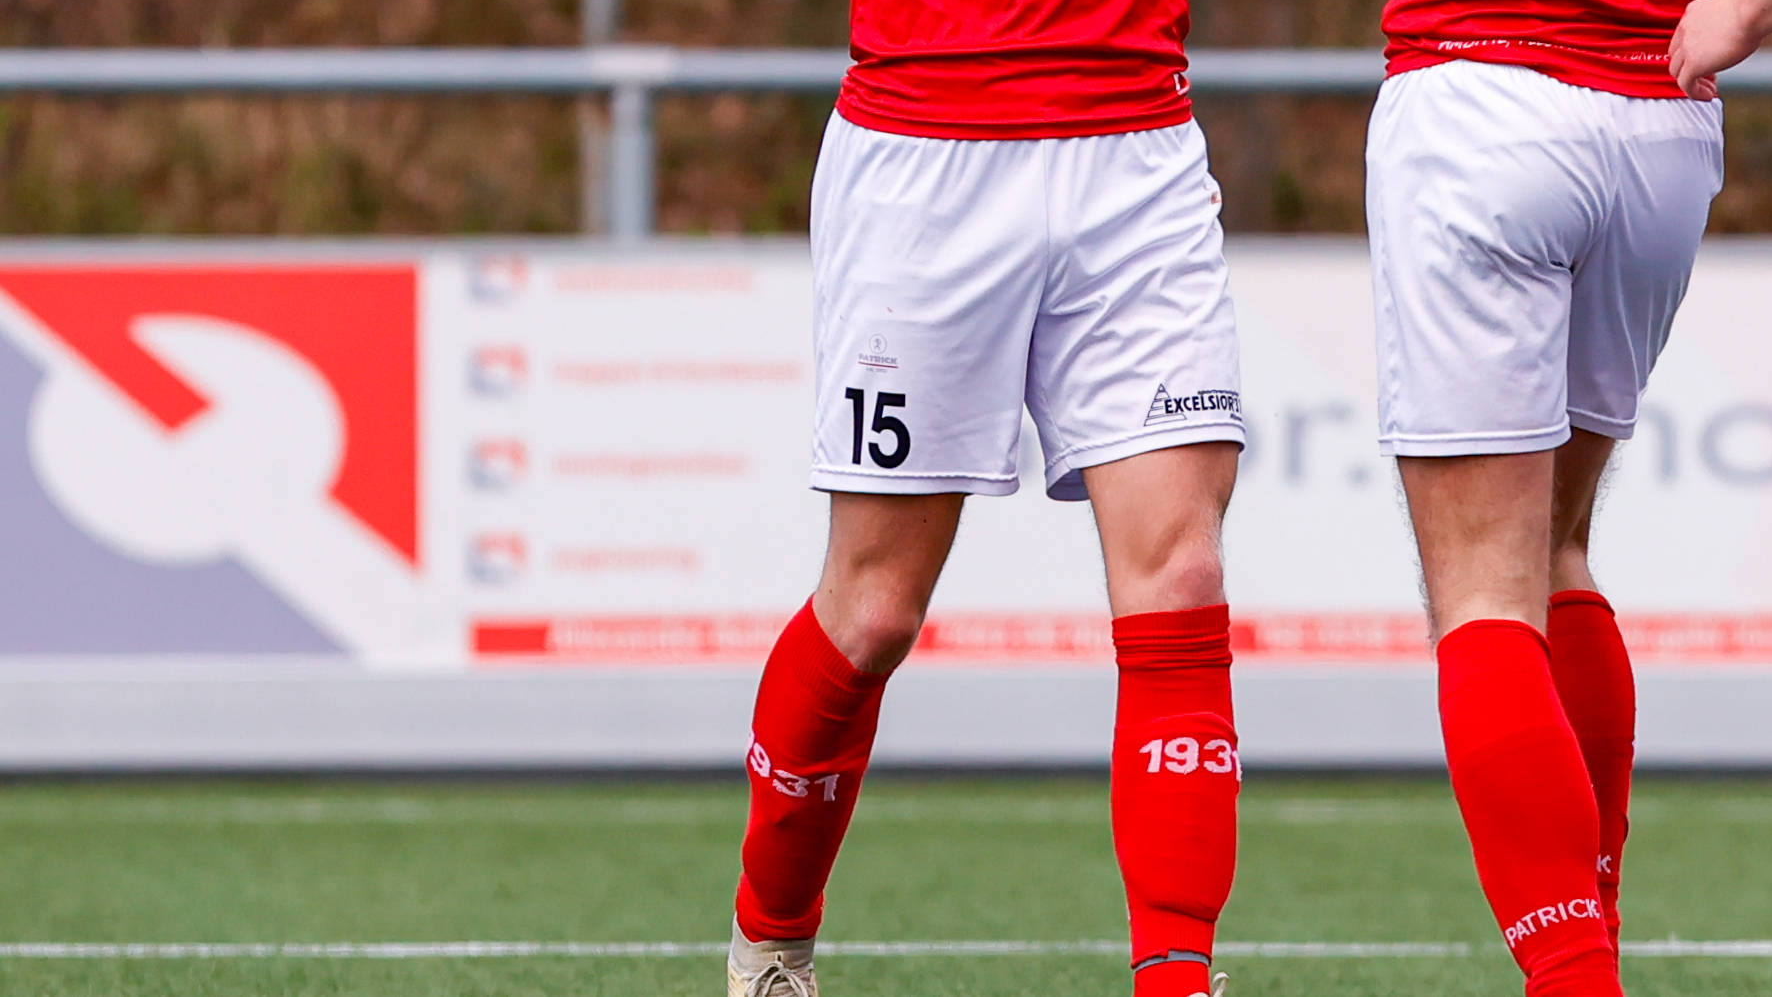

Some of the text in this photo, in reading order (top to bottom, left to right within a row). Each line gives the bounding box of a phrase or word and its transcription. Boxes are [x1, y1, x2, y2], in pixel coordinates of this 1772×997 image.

[858, 353, 898, 365] PATRICK
[845, 387, 911, 469] 15
[1504, 898, 1600, 948] PATRICK
